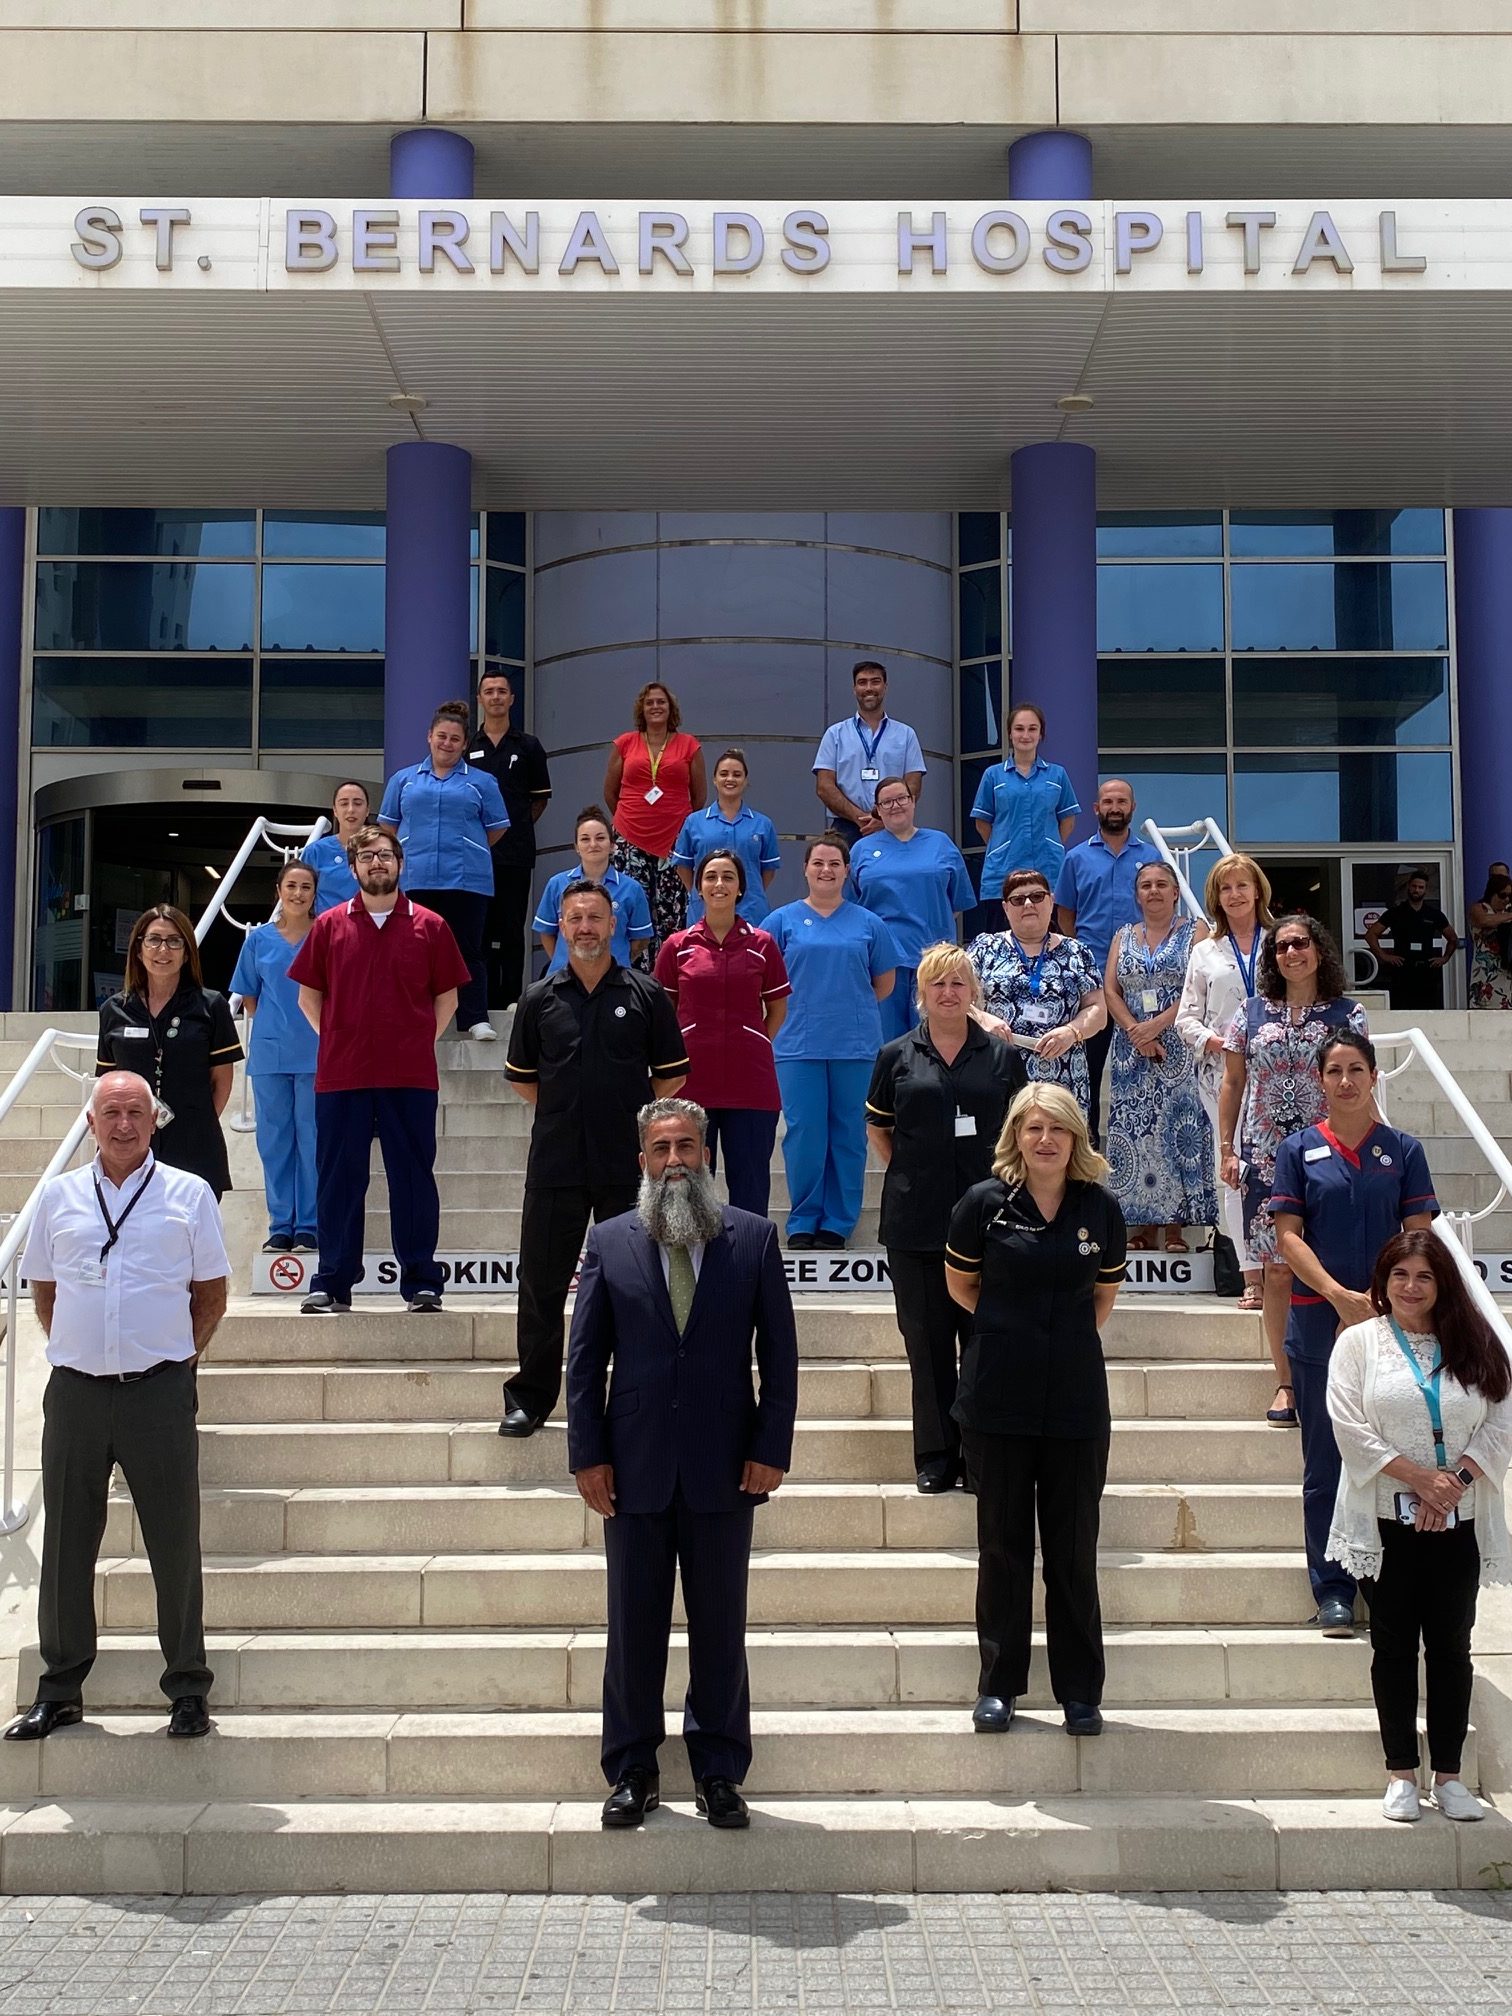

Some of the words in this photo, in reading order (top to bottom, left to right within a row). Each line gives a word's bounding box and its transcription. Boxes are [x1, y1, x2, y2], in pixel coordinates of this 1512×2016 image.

[70, 206, 212, 272] ST.
[286, 209, 831, 275] BERNARDS
[898, 209, 1427, 275] HOSPITAL
[377, 1260, 520, 1284] SKIN
[829, 1259, 893, 1283] ZON
